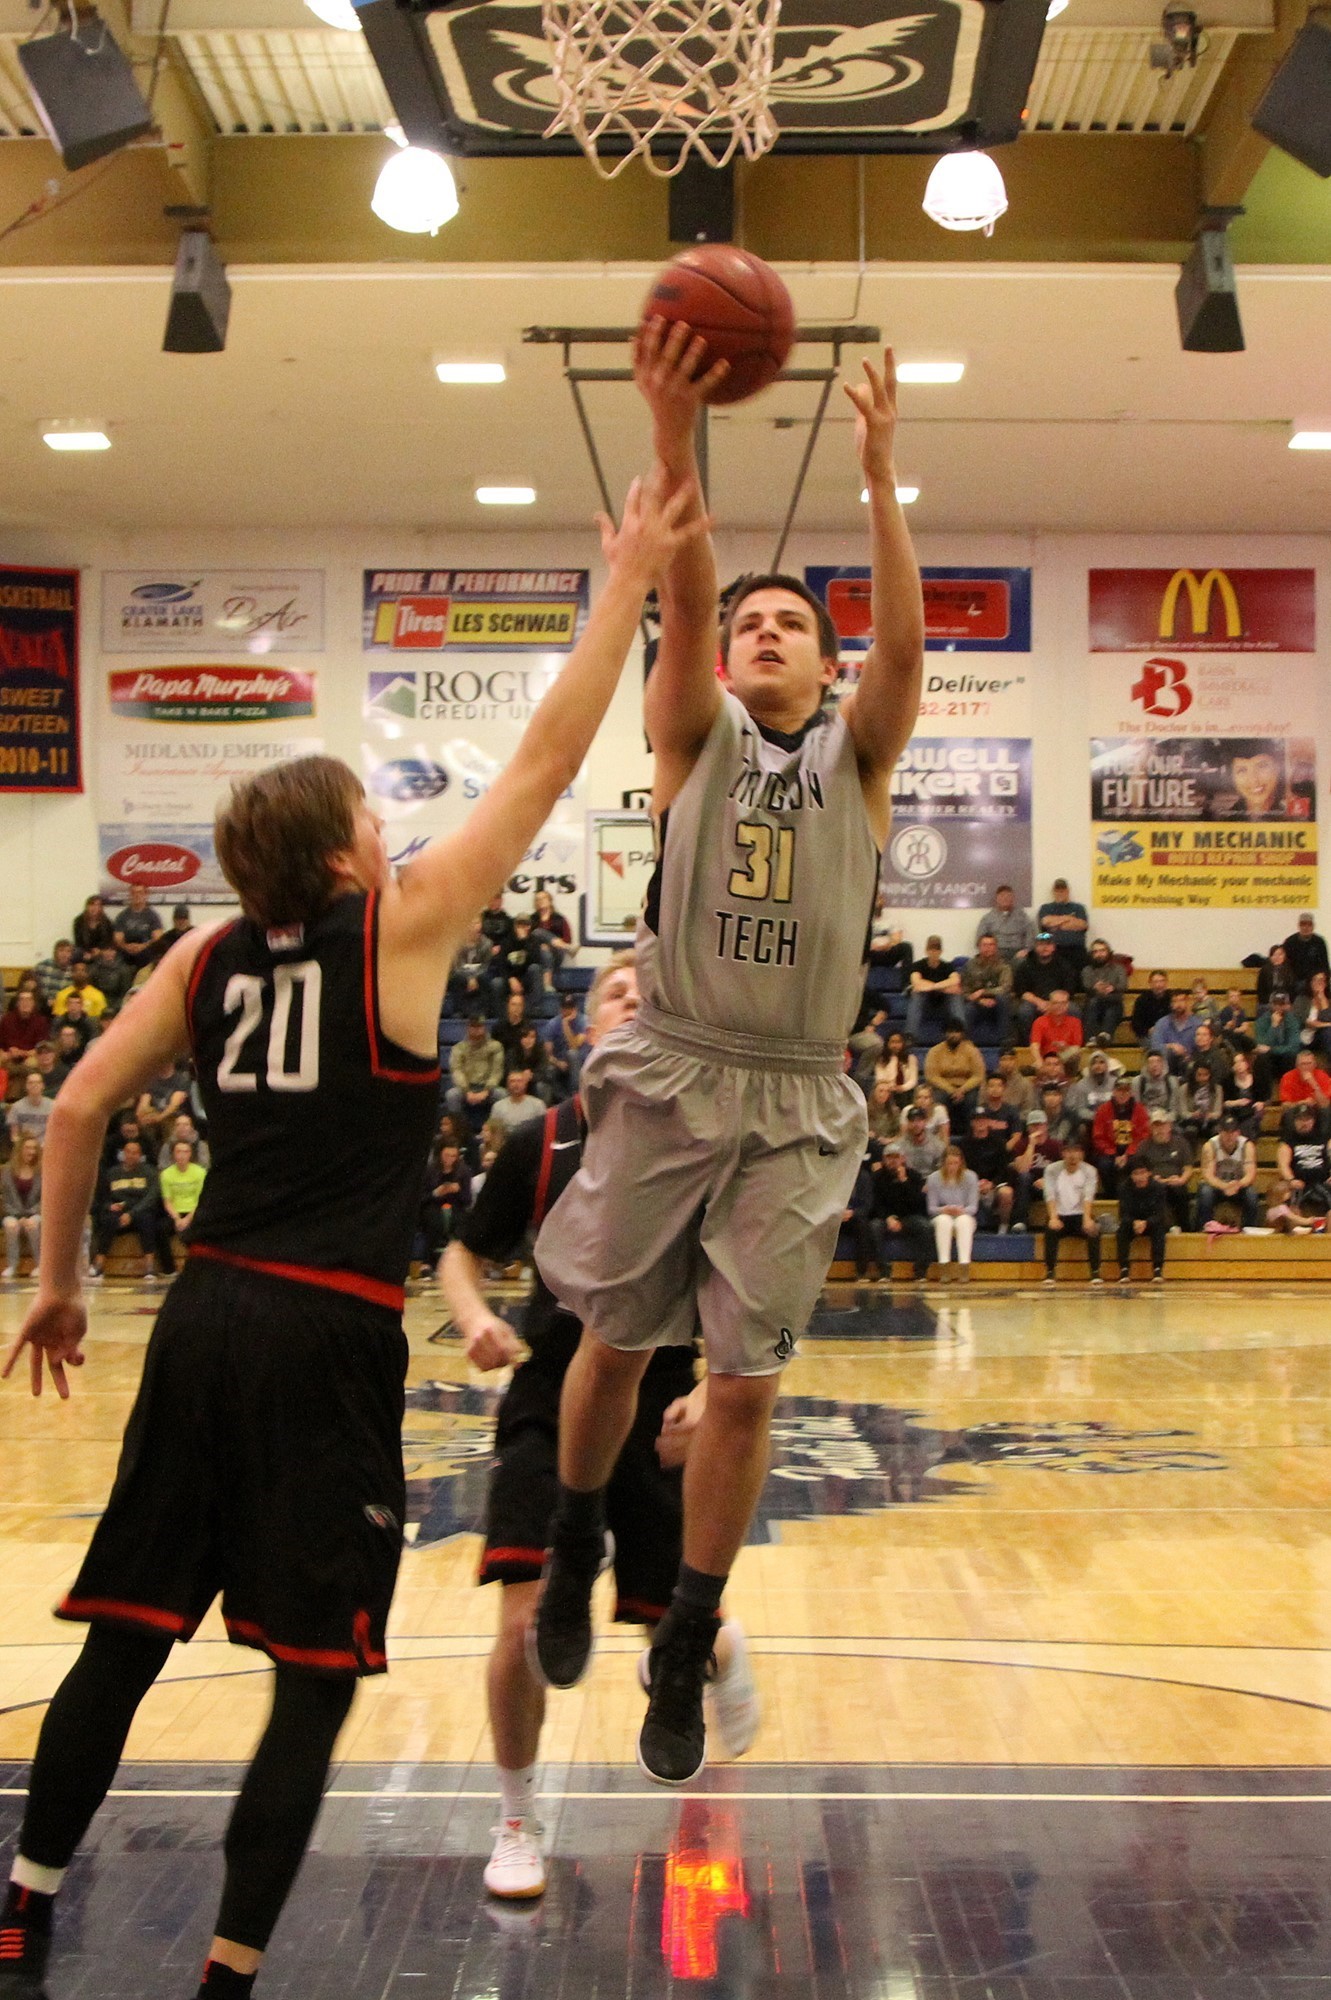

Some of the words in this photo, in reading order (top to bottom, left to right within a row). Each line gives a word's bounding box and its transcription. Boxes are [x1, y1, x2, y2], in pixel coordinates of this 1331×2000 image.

[371, 572, 425, 593] PRIDE
[428, 572, 451, 593] IN
[452, 572, 582, 593] PERFORMANCE
[174, 605, 204, 616] LAKE
[397, 604, 446, 637] Tires
[121, 616, 204, 628] KLAMATH
[453, 613, 485, 633] LES
[488, 613, 571, 633] SCHWAB
[0, 687, 65, 706] SWEET
[129, 673, 195, 700] Papa
[194, 673, 293, 701] Murphy's
[422, 670, 563, 703] ROGU
[232, 706, 268, 716] PIZZA
[420, 704, 499, 720] CREDIT
[125, 743, 218, 759] MIDLAND
[1102, 778, 1197, 807] FUTURE
[1151, 831, 1184, 848] MY
[1194, 831, 1307, 848] MECHANIC
[119, 853, 189, 876] Coastal
[728, 821, 795, 903] 31
[933, 882, 987, 895] RANCH
[1097, 873, 1132, 886] Make
[1135, 873, 1154, 889] My
[1157, 873, 1218, 886] Mechanic
[1252, 873, 1314, 886] mechanic
[715, 910, 801, 968] TECH
[216, 959, 322, 1093] 20
